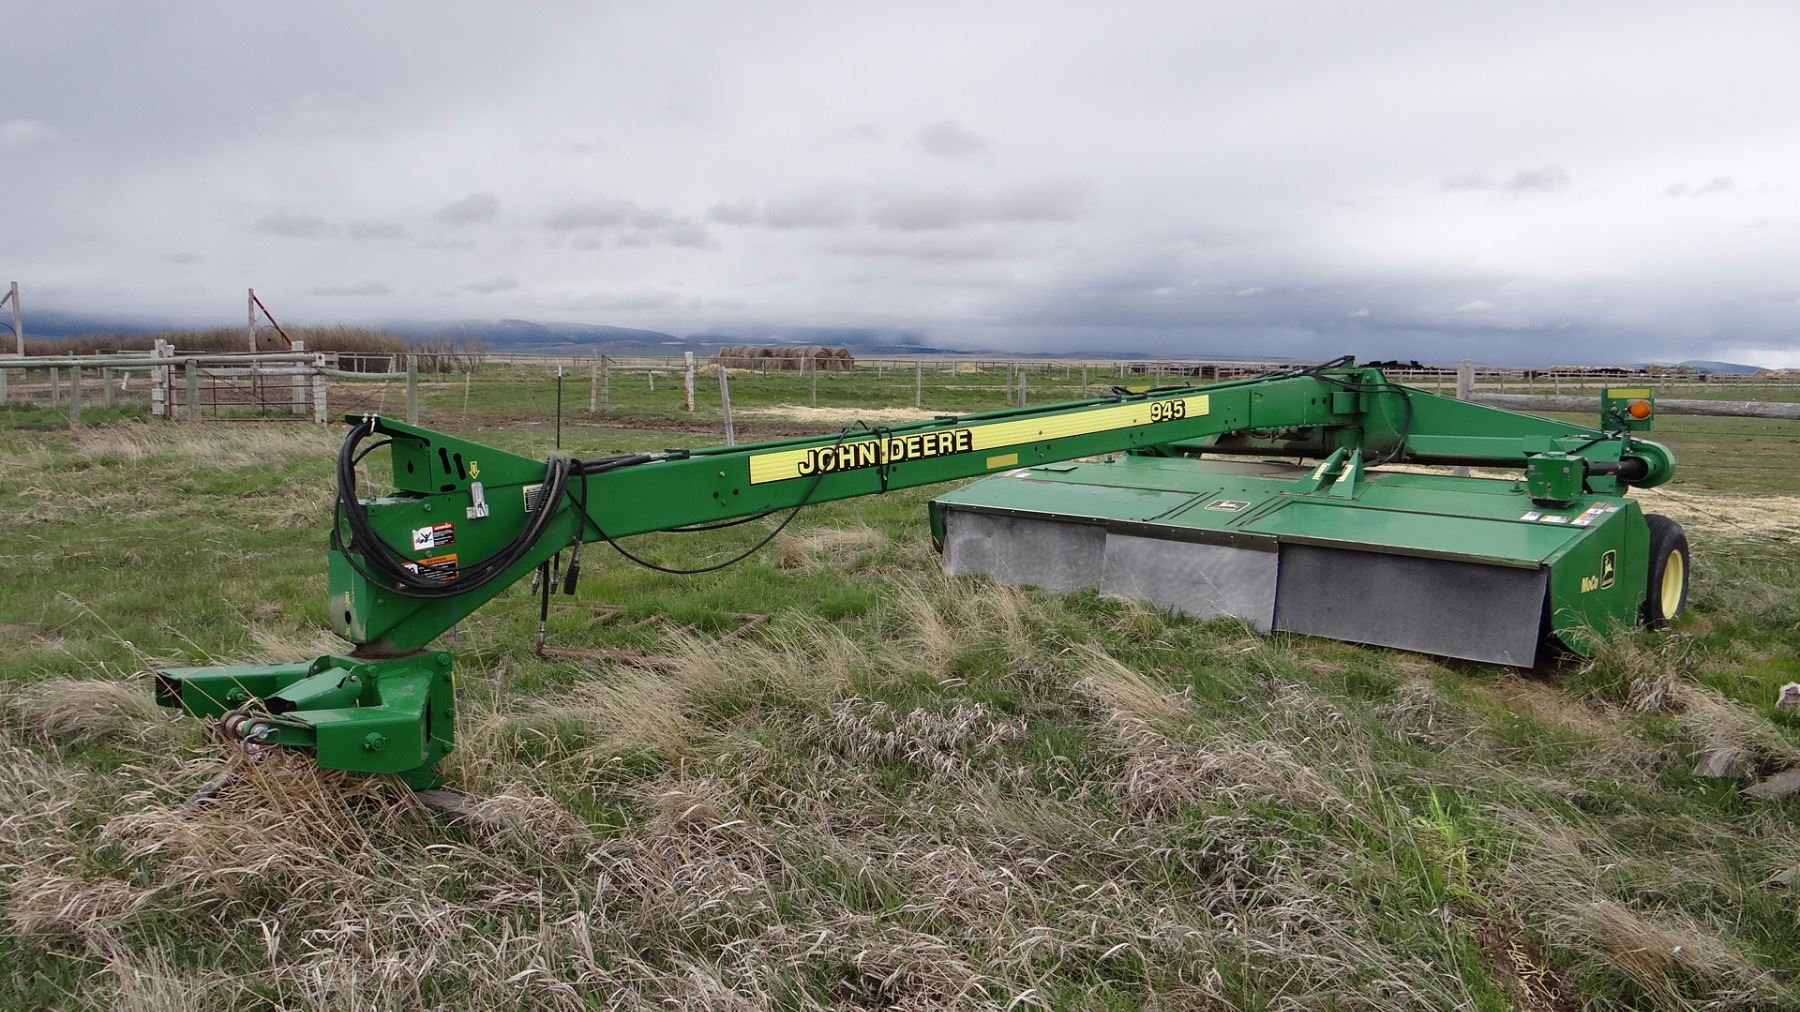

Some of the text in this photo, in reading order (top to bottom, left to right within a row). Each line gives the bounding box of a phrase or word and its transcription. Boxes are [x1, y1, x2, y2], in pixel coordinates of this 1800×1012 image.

[1151, 399, 1185, 422] 945
[798, 429, 972, 476] JOHN DEERE
